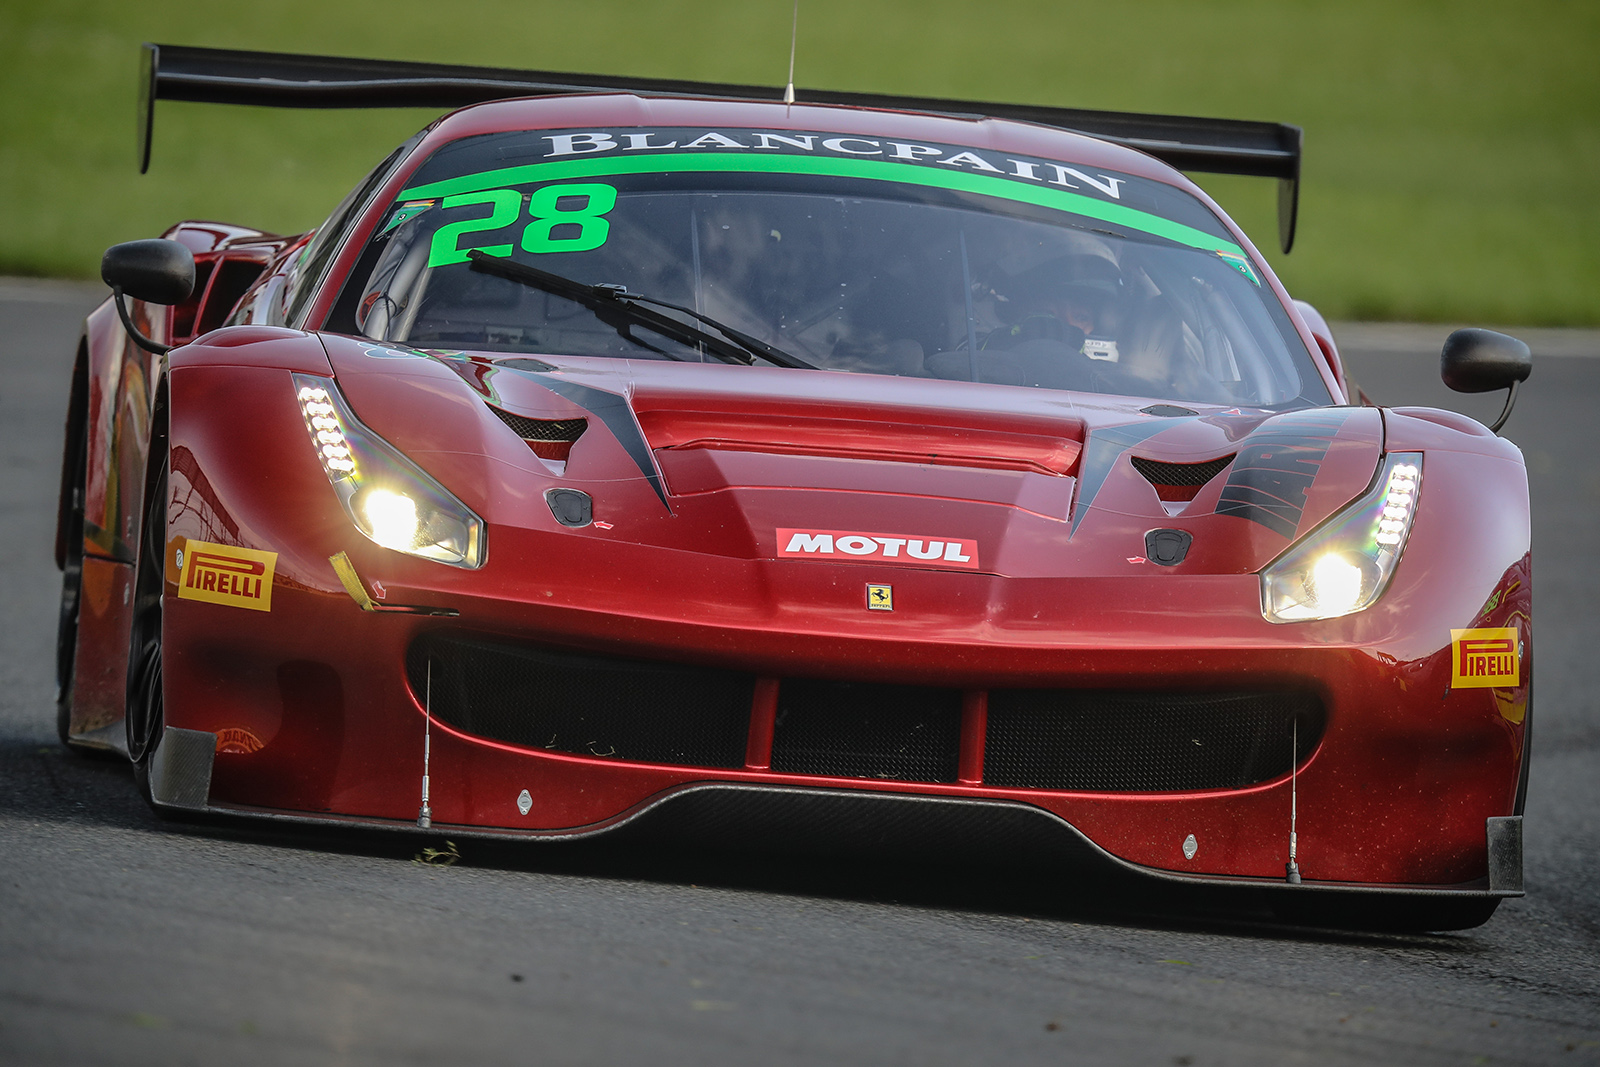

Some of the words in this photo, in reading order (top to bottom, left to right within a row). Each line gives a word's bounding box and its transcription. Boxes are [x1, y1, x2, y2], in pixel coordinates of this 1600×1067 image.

[542, 131, 1126, 200] BLANCPAIN
[428, 183, 618, 269] 28
[785, 533, 971, 563] MOTUL
[186, 551, 265, 599] PIRELLI
[1459, 639, 1514, 677] PIRELLI
